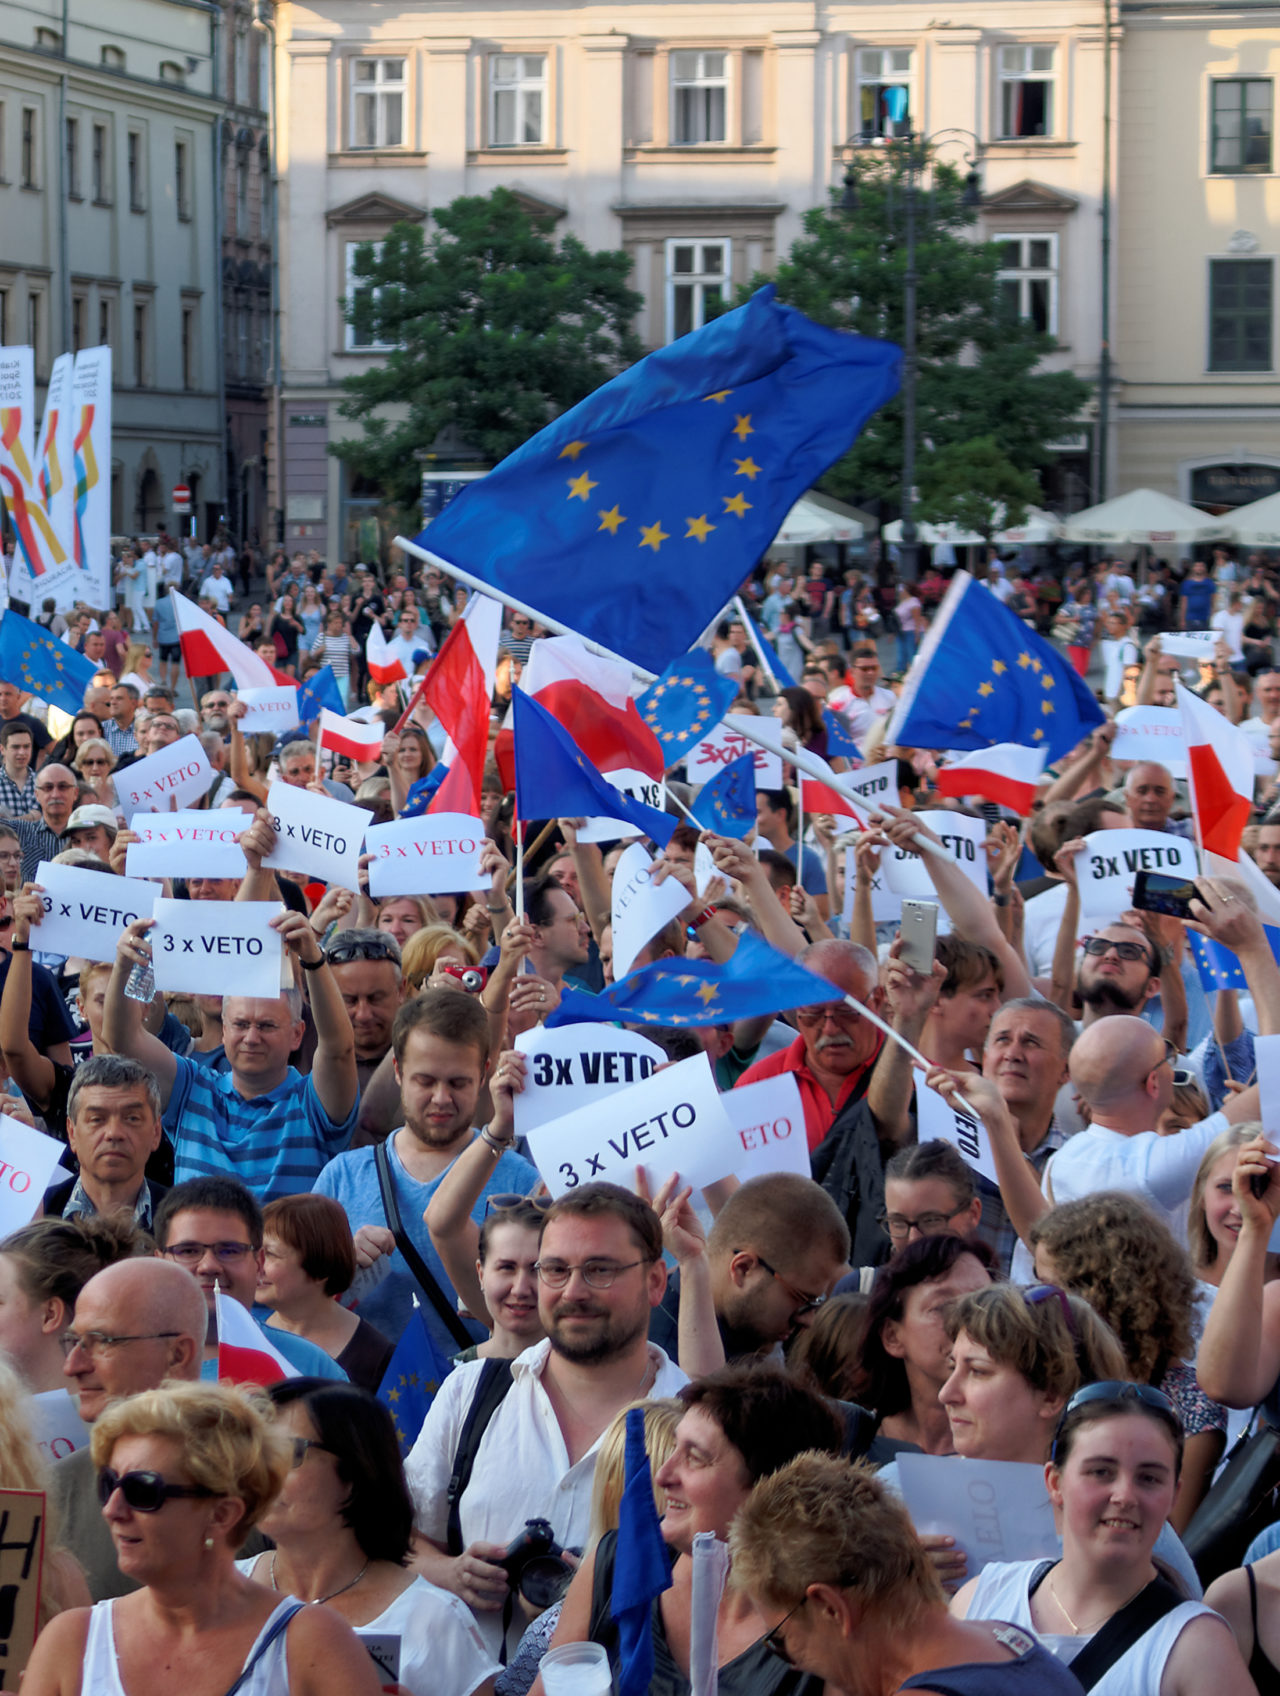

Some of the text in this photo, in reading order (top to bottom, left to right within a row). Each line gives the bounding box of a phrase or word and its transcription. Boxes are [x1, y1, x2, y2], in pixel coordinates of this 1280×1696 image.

[258, 701, 292, 714] VETO
[130, 760, 201, 806] 3 x VETO
[141, 828, 237, 844] 3 x VETO
[273, 815, 347, 856] 3 x VETO
[380, 838, 477, 860] 3 x VETO
[1090, 847, 1182, 881] 3x VETO
[43, 896, 139, 929] 3 x VETO
[163, 934, 264, 956] 3 x VETO
[533, 1051, 657, 1087] 3x VETO
[558, 1101, 698, 1189] 3 x VETO
